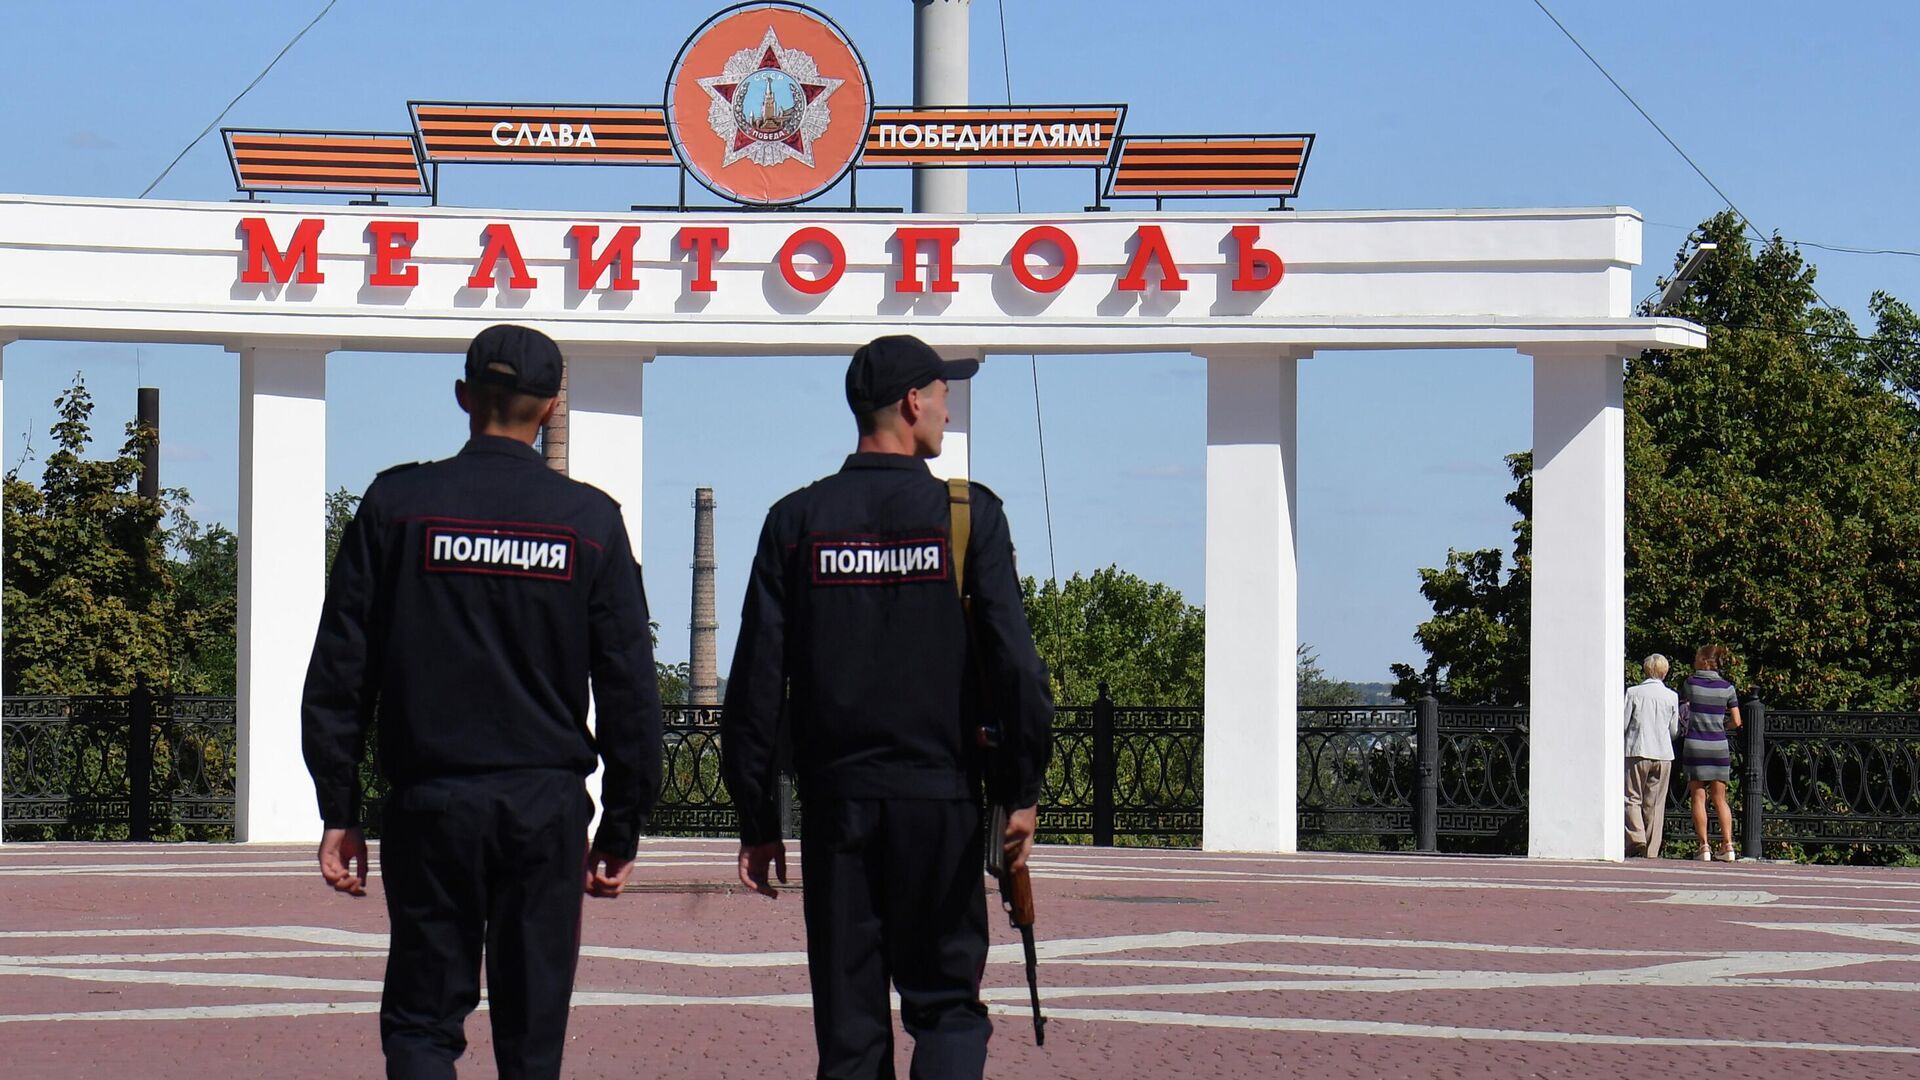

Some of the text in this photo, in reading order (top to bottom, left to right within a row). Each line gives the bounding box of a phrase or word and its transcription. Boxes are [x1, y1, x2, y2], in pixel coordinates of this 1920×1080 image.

[491, 122, 597, 147] СЛАВА
[752, 130, 785, 140] ПОБЕДА
[879, 123, 1101, 151] ПОБЕДИТЕЛЯМ!
[241, 218, 1284, 293] МЕЛИТОПОЛЬ
[433, 535, 567, 570] ПОЛИЦИЯ
[820, 546, 940, 575] ПОЛИЦИЯ
